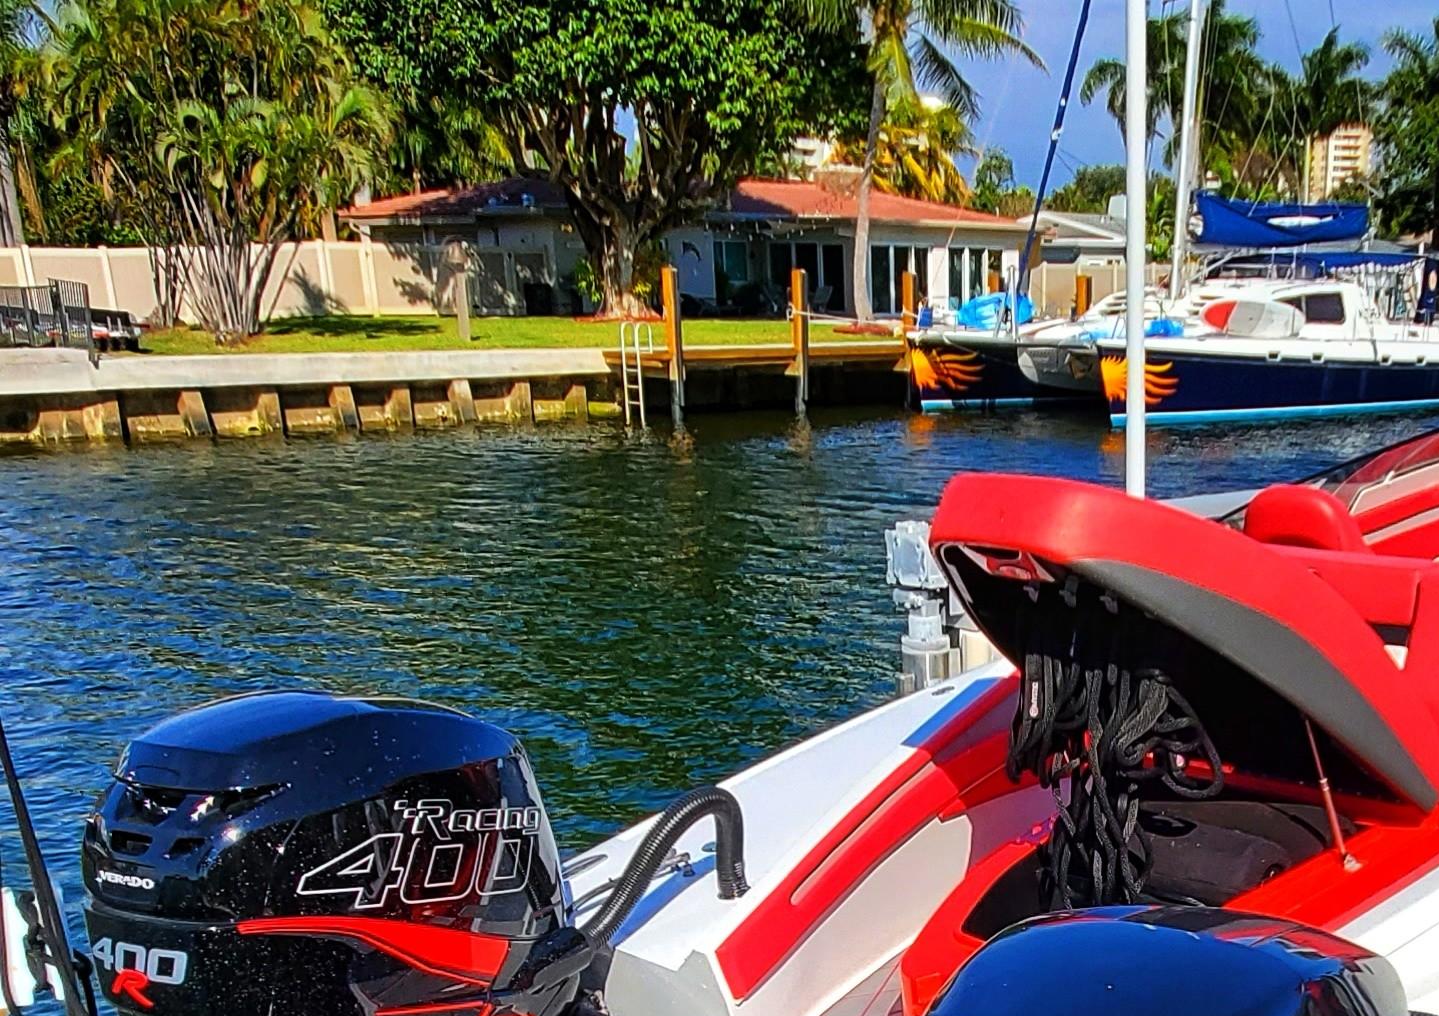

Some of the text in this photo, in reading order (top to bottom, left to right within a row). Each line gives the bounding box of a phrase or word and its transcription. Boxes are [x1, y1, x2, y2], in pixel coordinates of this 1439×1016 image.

[411, 799, 541, 841] Racing
[97, 870, 155, 890] VERADO
[296, 832, 534, 909] 400
[92, 936, 188, 985] 400
[111, 968, 155, 1009] R
